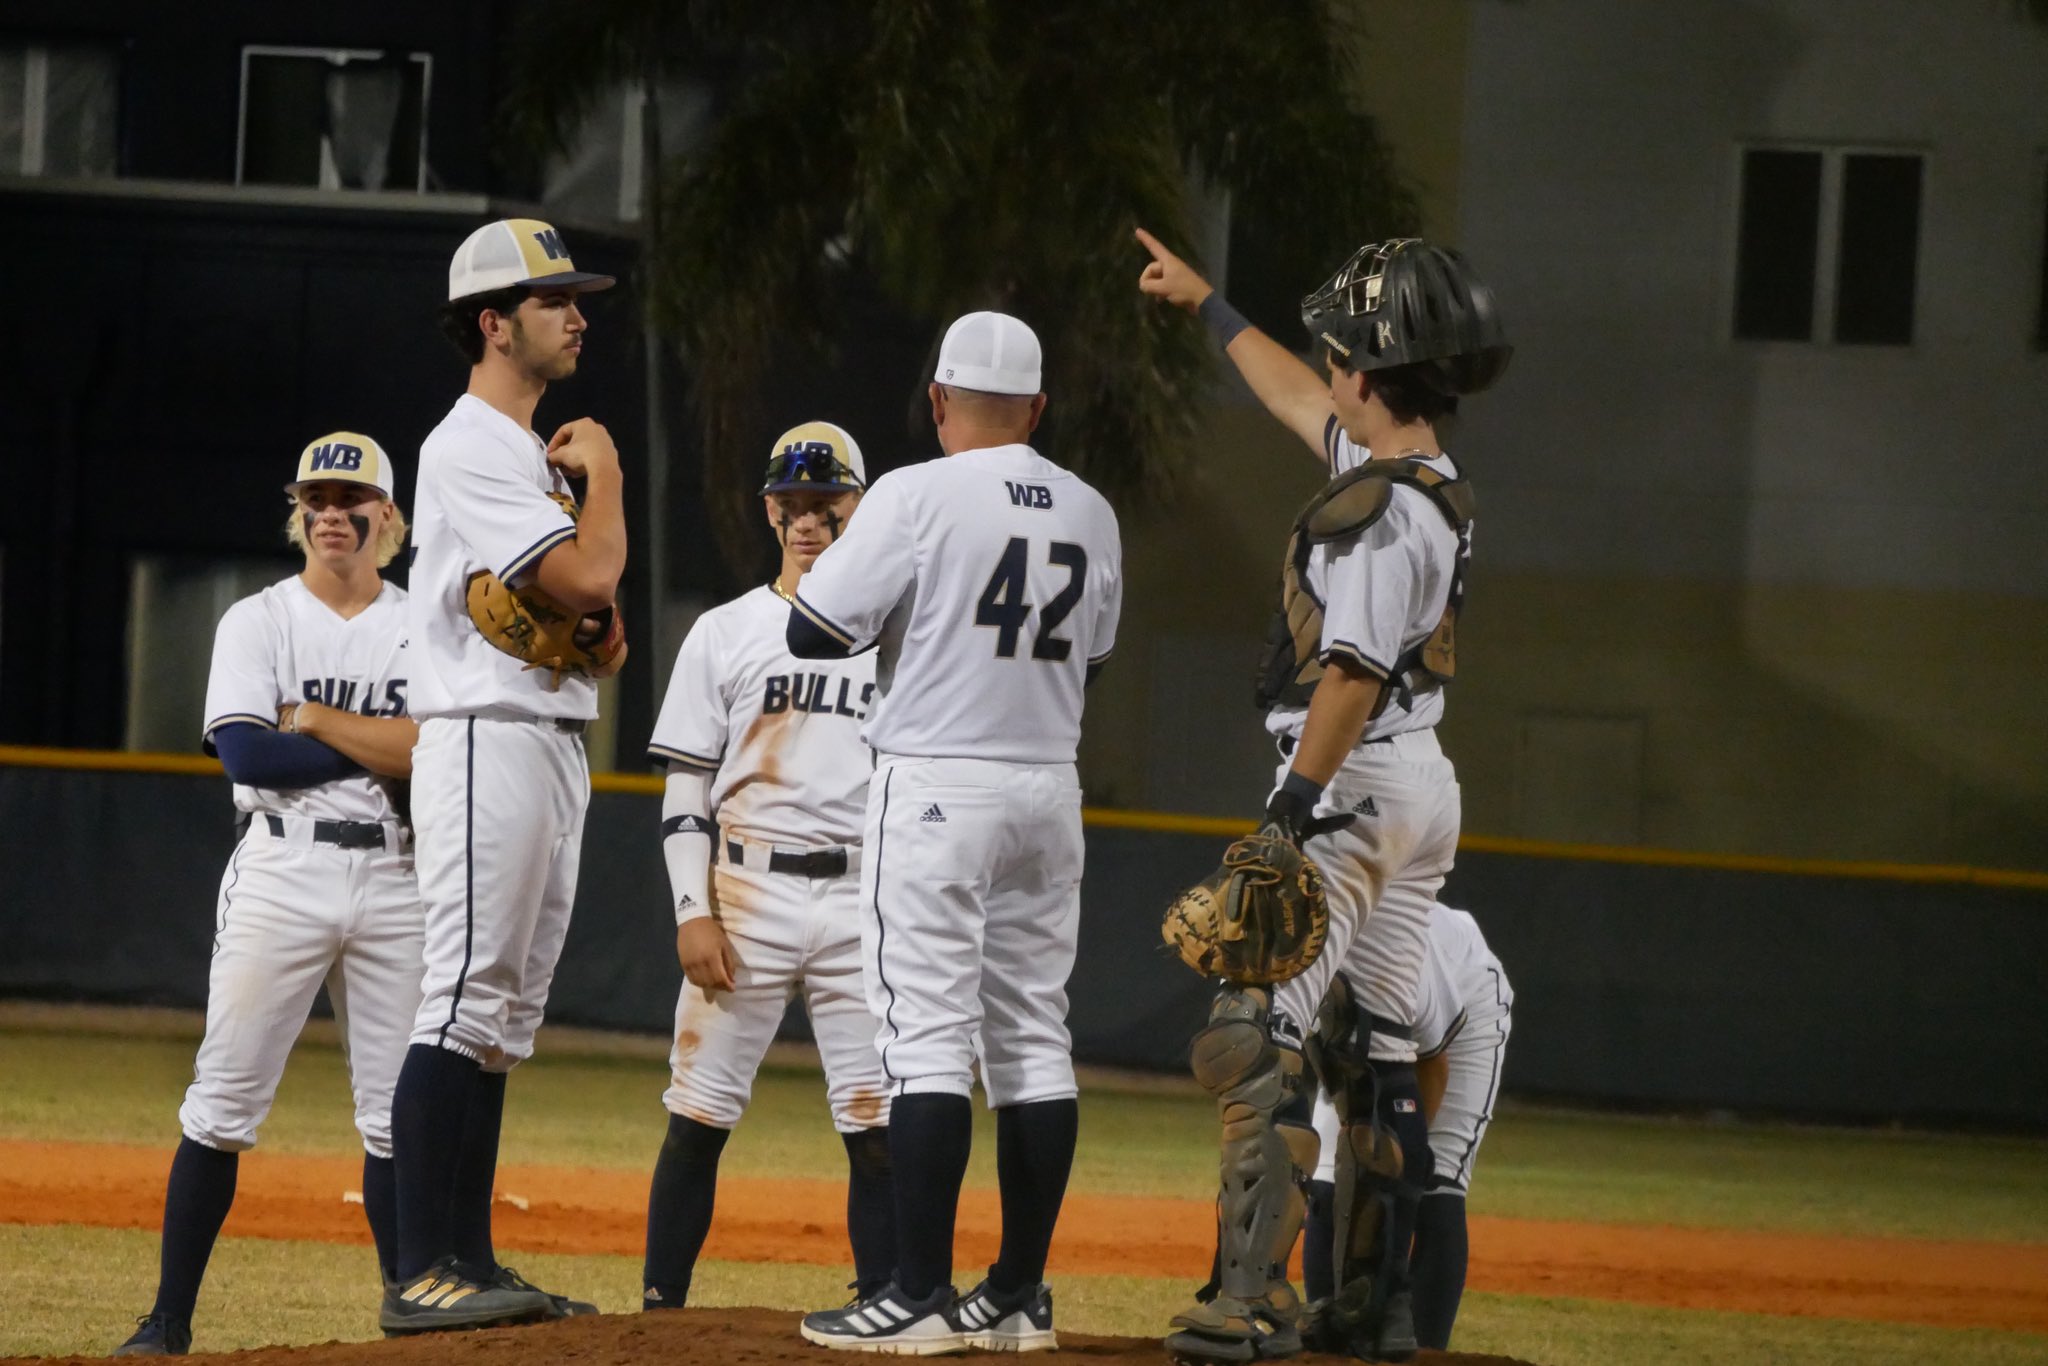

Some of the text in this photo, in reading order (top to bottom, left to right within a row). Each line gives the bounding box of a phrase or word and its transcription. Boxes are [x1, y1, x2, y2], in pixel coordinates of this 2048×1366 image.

[533, 229, 570, 260] W
[310, 443, 363, 472] WB
[1005, 481, 1053, 510] WB
[973, 535, 1087, 662] 42
